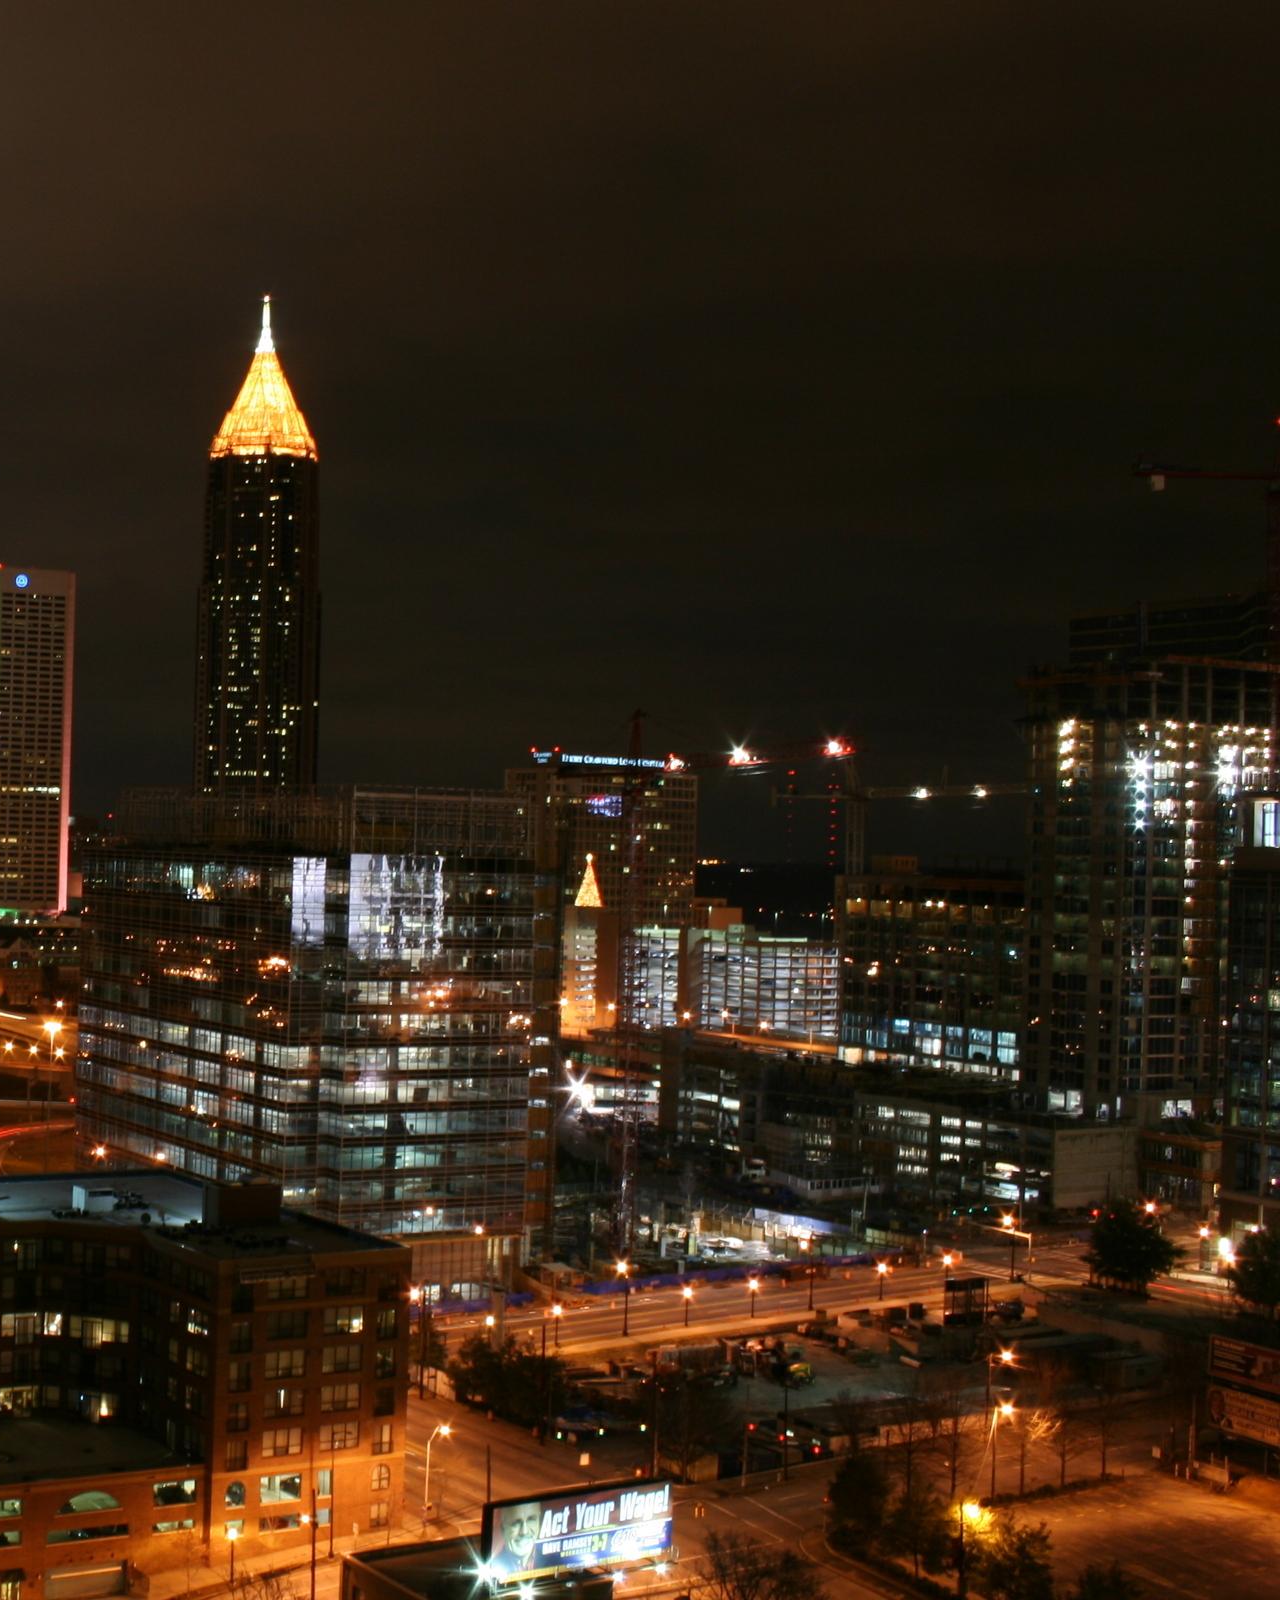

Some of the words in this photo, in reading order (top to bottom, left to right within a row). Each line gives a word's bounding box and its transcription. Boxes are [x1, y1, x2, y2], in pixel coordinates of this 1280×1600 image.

[540, 1505, 570, 1539] Act
[575, 1501, 615, 1531] Your
[619, 1483, 670, 1522] Wage!
